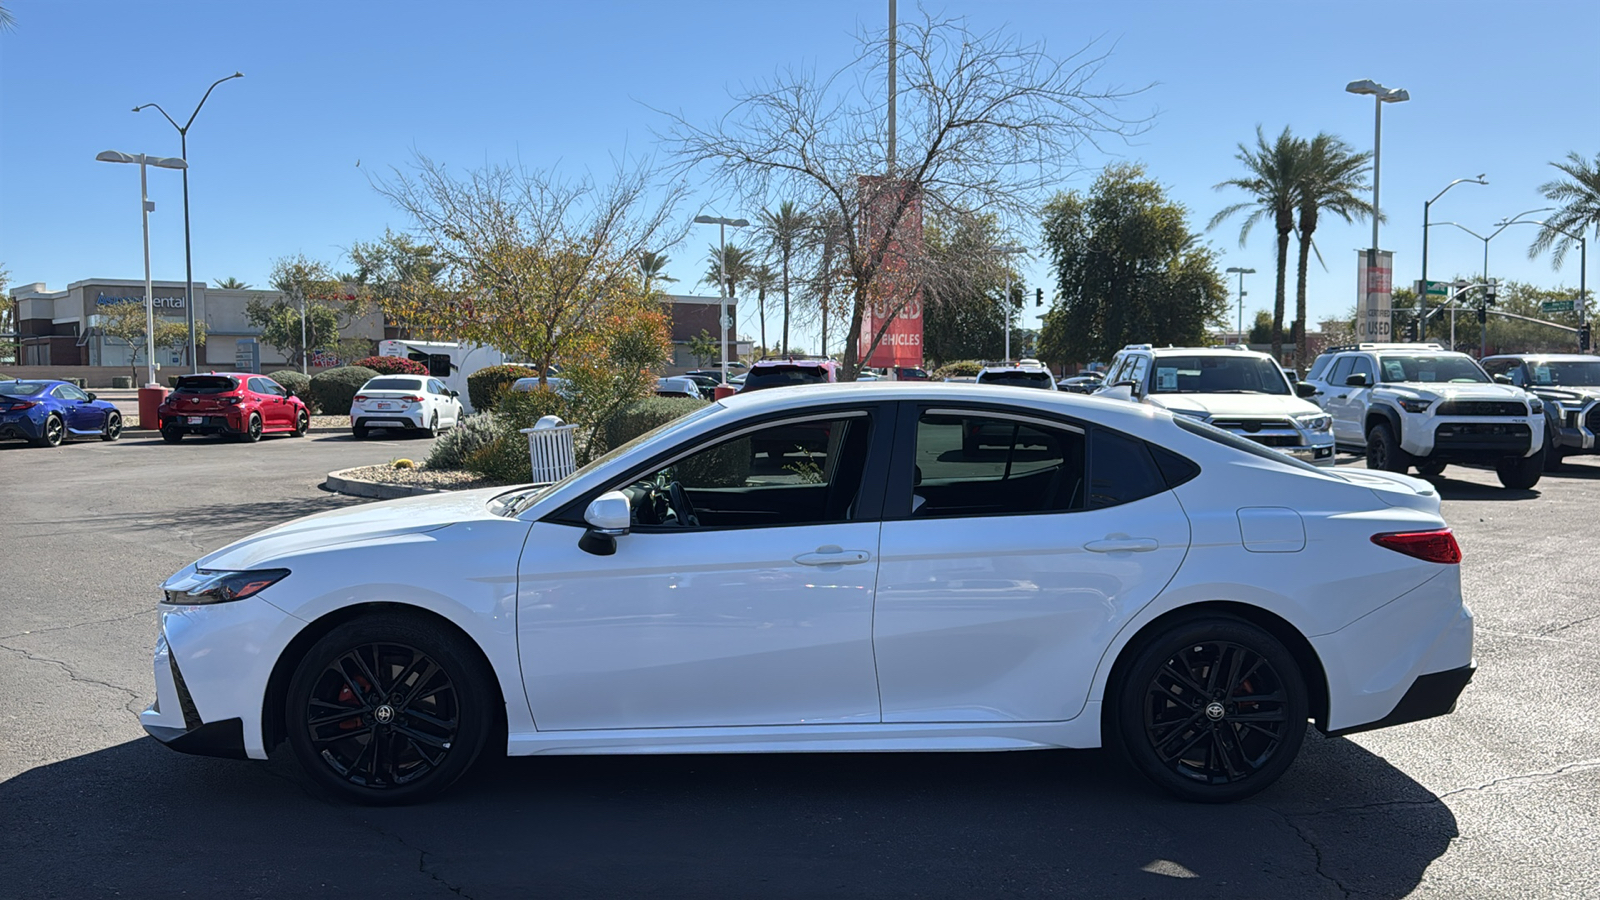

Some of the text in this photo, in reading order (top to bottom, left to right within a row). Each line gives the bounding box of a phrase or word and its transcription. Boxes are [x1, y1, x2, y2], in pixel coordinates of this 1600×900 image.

[874, 297, 920, 319] UED
[1368, 321, 1390, 336] USED
[874, 333, 920, 346] EHICLES
